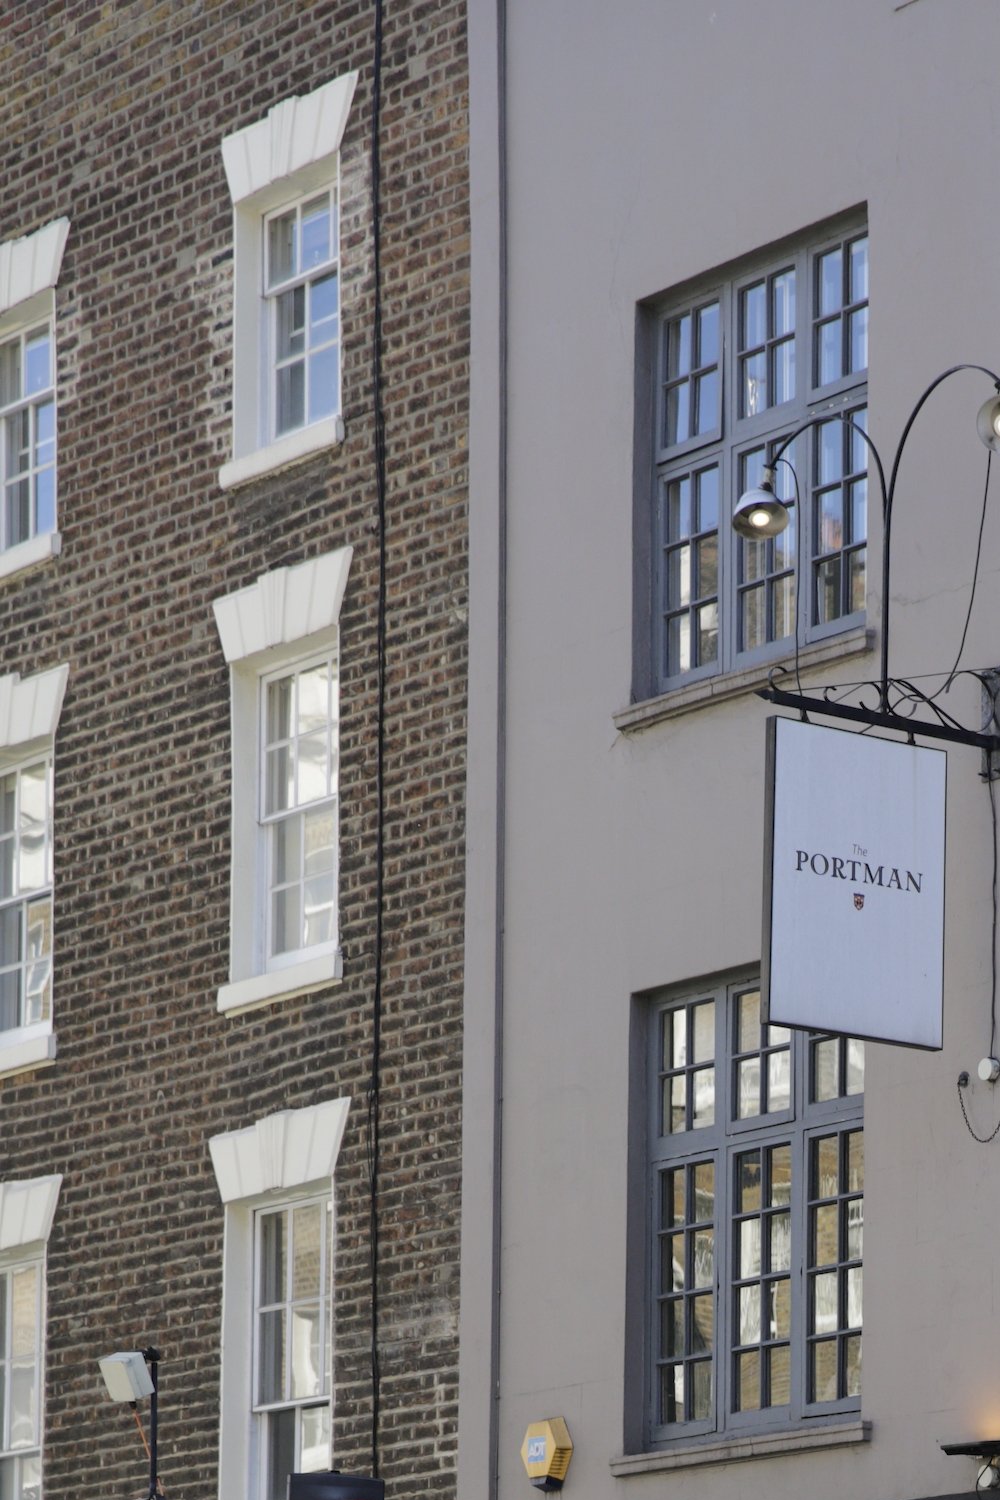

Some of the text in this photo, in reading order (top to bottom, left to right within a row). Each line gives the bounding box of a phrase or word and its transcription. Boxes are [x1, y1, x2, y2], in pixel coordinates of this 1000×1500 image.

[852, 844, 868, 857] The
[795, 850, 923, 894] PORTMAN
[528, 1441, 546, 1457] ADT
